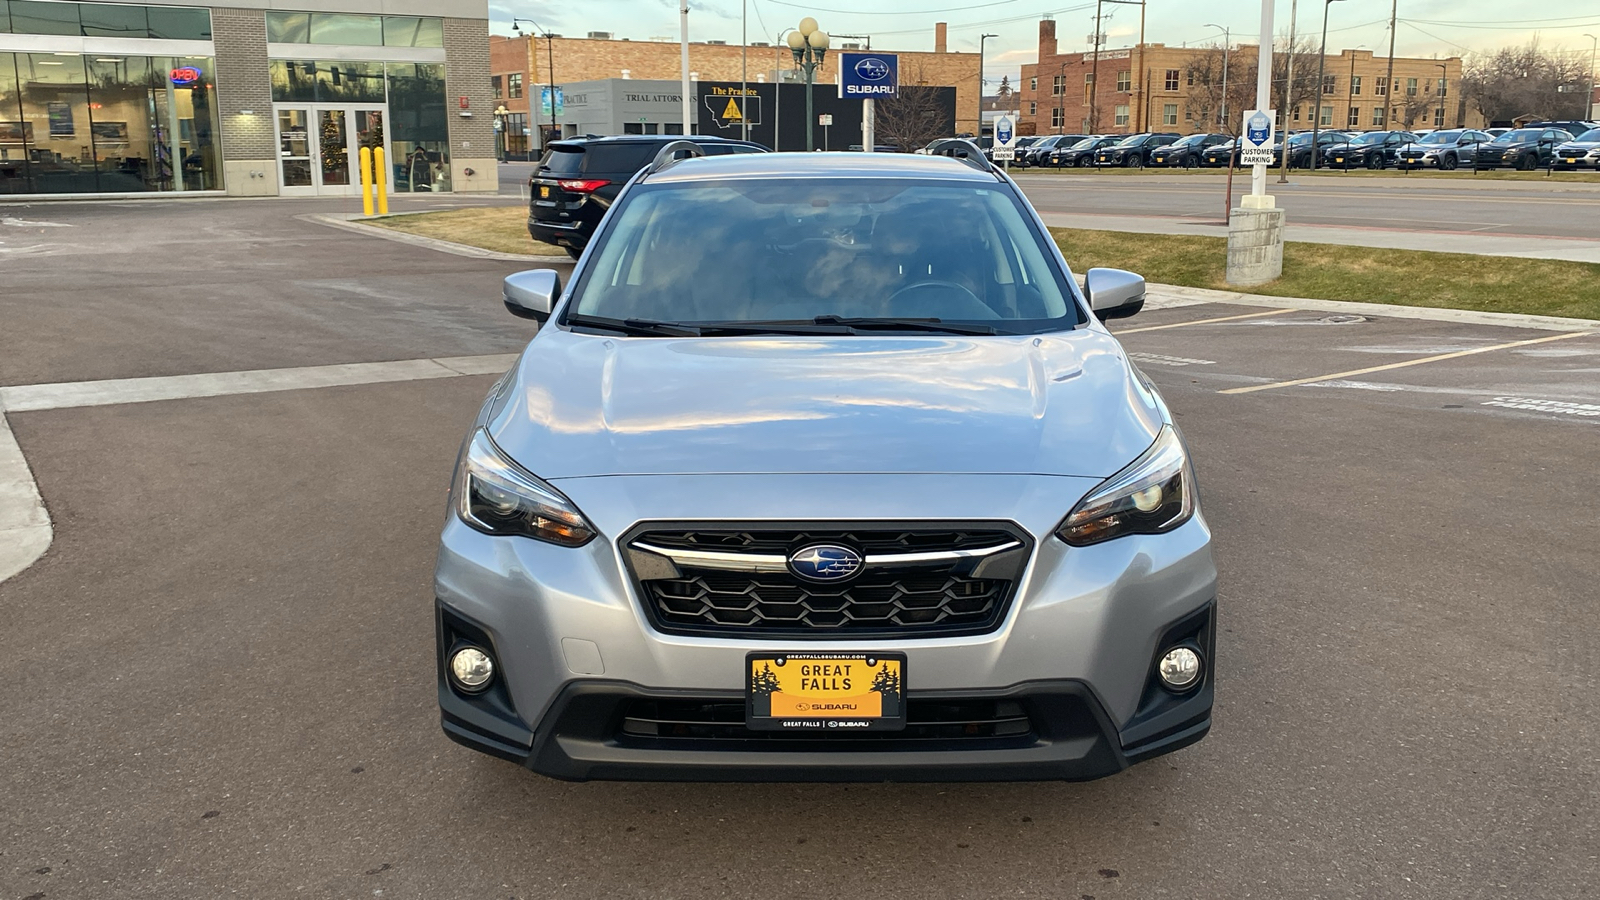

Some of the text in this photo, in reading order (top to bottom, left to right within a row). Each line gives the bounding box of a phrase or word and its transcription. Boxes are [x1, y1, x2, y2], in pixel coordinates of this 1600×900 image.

[170, 69, 198, 80] OPEN
[712, 87, 727, 95] The
[847, 85, 894, 93] SUBARU
[626, 94, 650, 102] TRIAL
[801, 665, 852, 676] GREAT
[801, 678, 852, 691] FALLS
